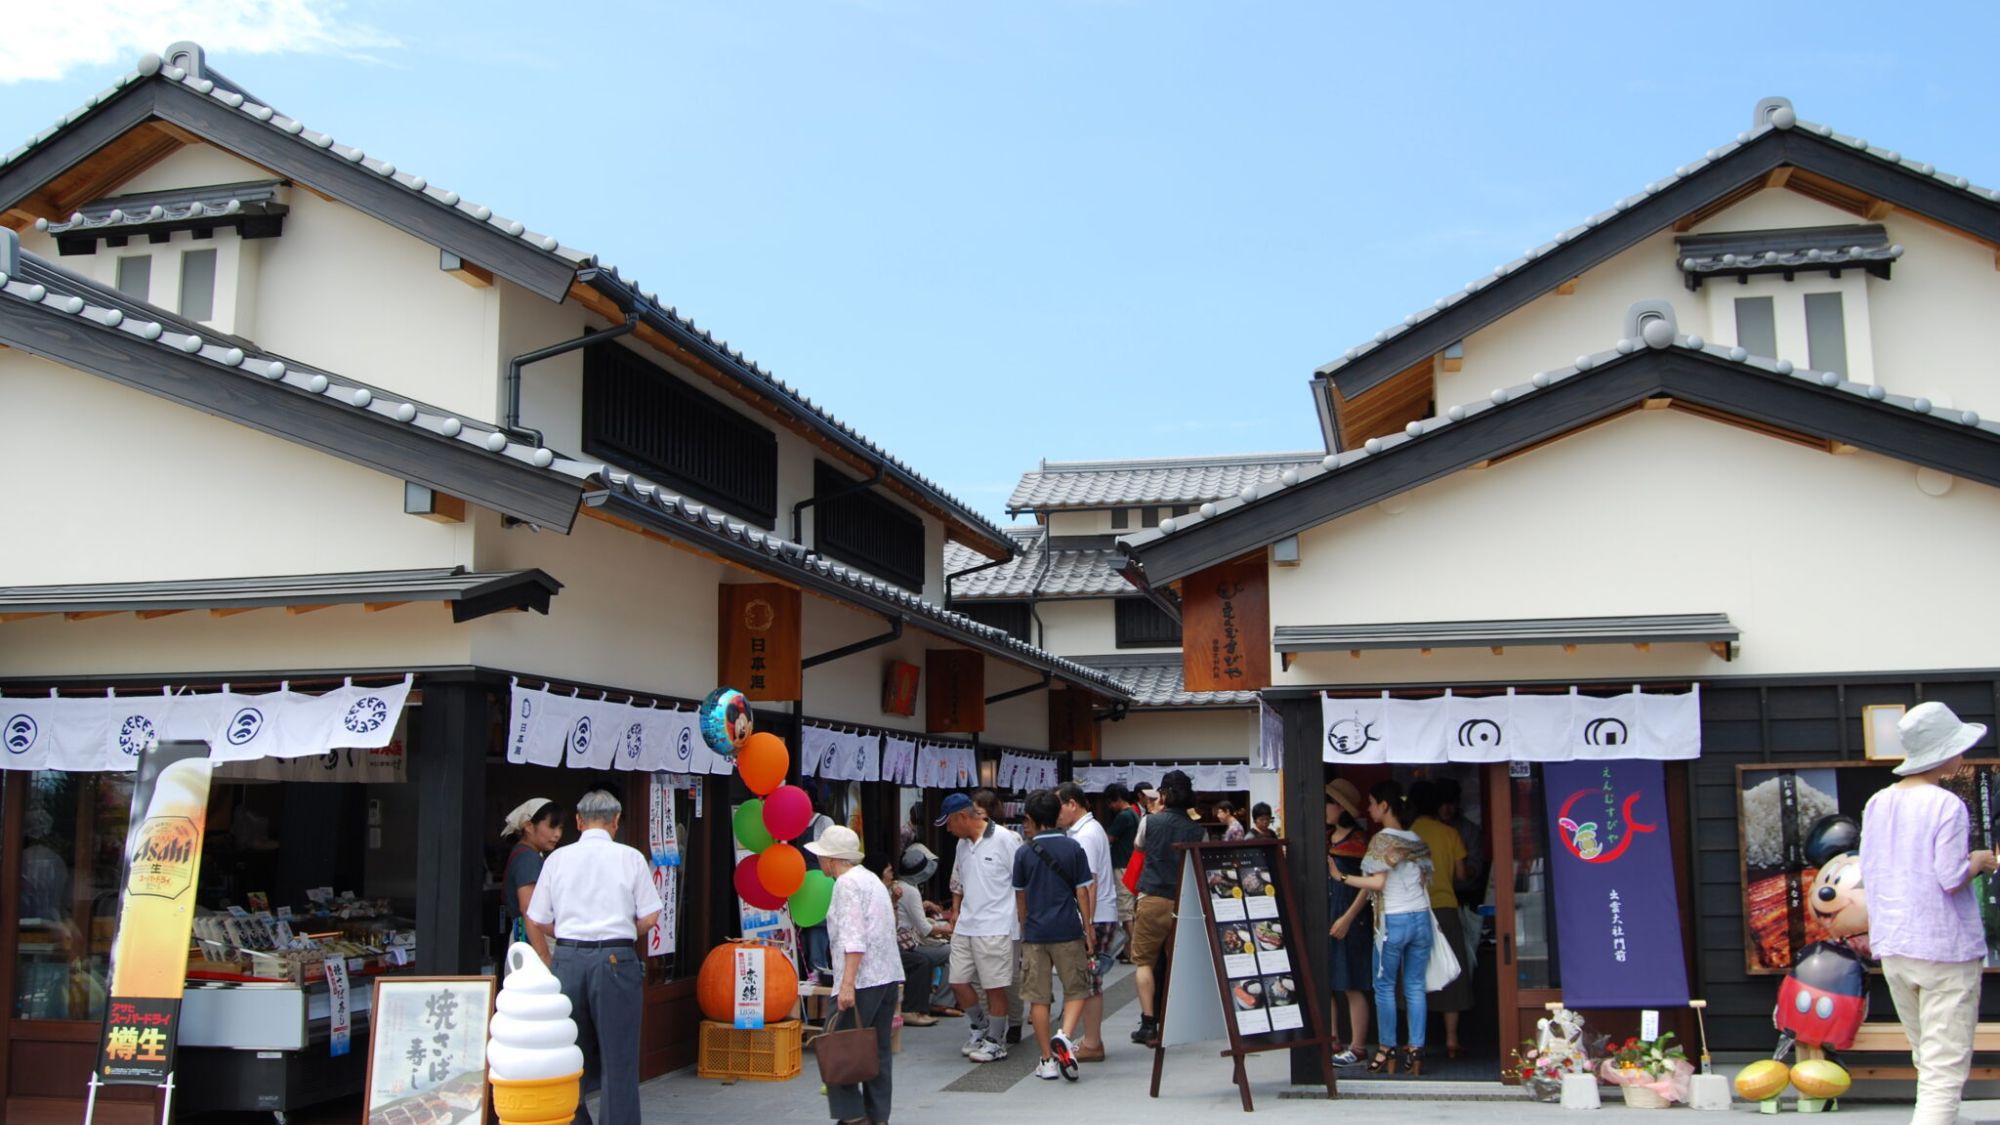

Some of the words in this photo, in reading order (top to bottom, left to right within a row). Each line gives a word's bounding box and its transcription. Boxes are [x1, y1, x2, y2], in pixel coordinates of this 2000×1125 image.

[750, 638, 766, 690] 日本海
[133, 837, 192, 864] Asahi
[1608, 888, 1627, 963] 出雲大社門前
[110, 1013, 173, 1025] スーパードライ
[111, 1003, 136, 1013] アサヒ
[106, 1026, 167, 1061] 樽生
[425, 988, 459, 1082] 焼さば
[406, 1037, 427, 1090] 寿し
